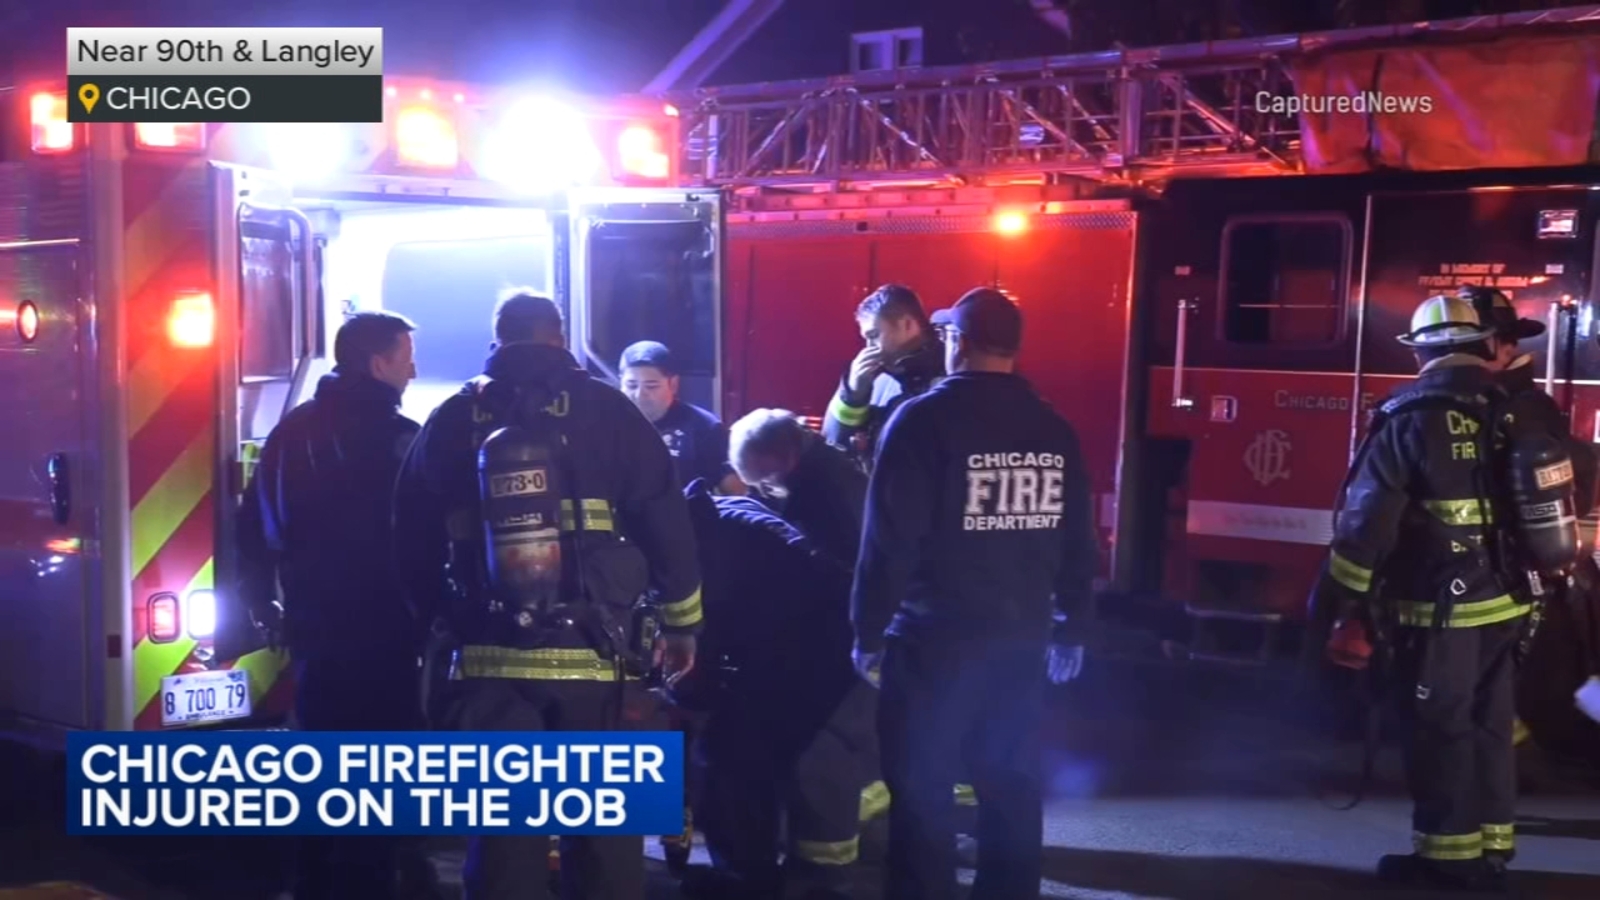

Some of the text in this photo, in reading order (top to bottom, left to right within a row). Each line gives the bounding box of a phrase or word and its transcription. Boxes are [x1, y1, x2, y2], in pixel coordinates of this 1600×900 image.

[967, 452, 1064, 469] CHICAGO
[965, 468, 1063, 515] FIRE
[963, 514, 1062, 531] DEPARTMENT
[165, 683, 246, 715] 8 700 79
